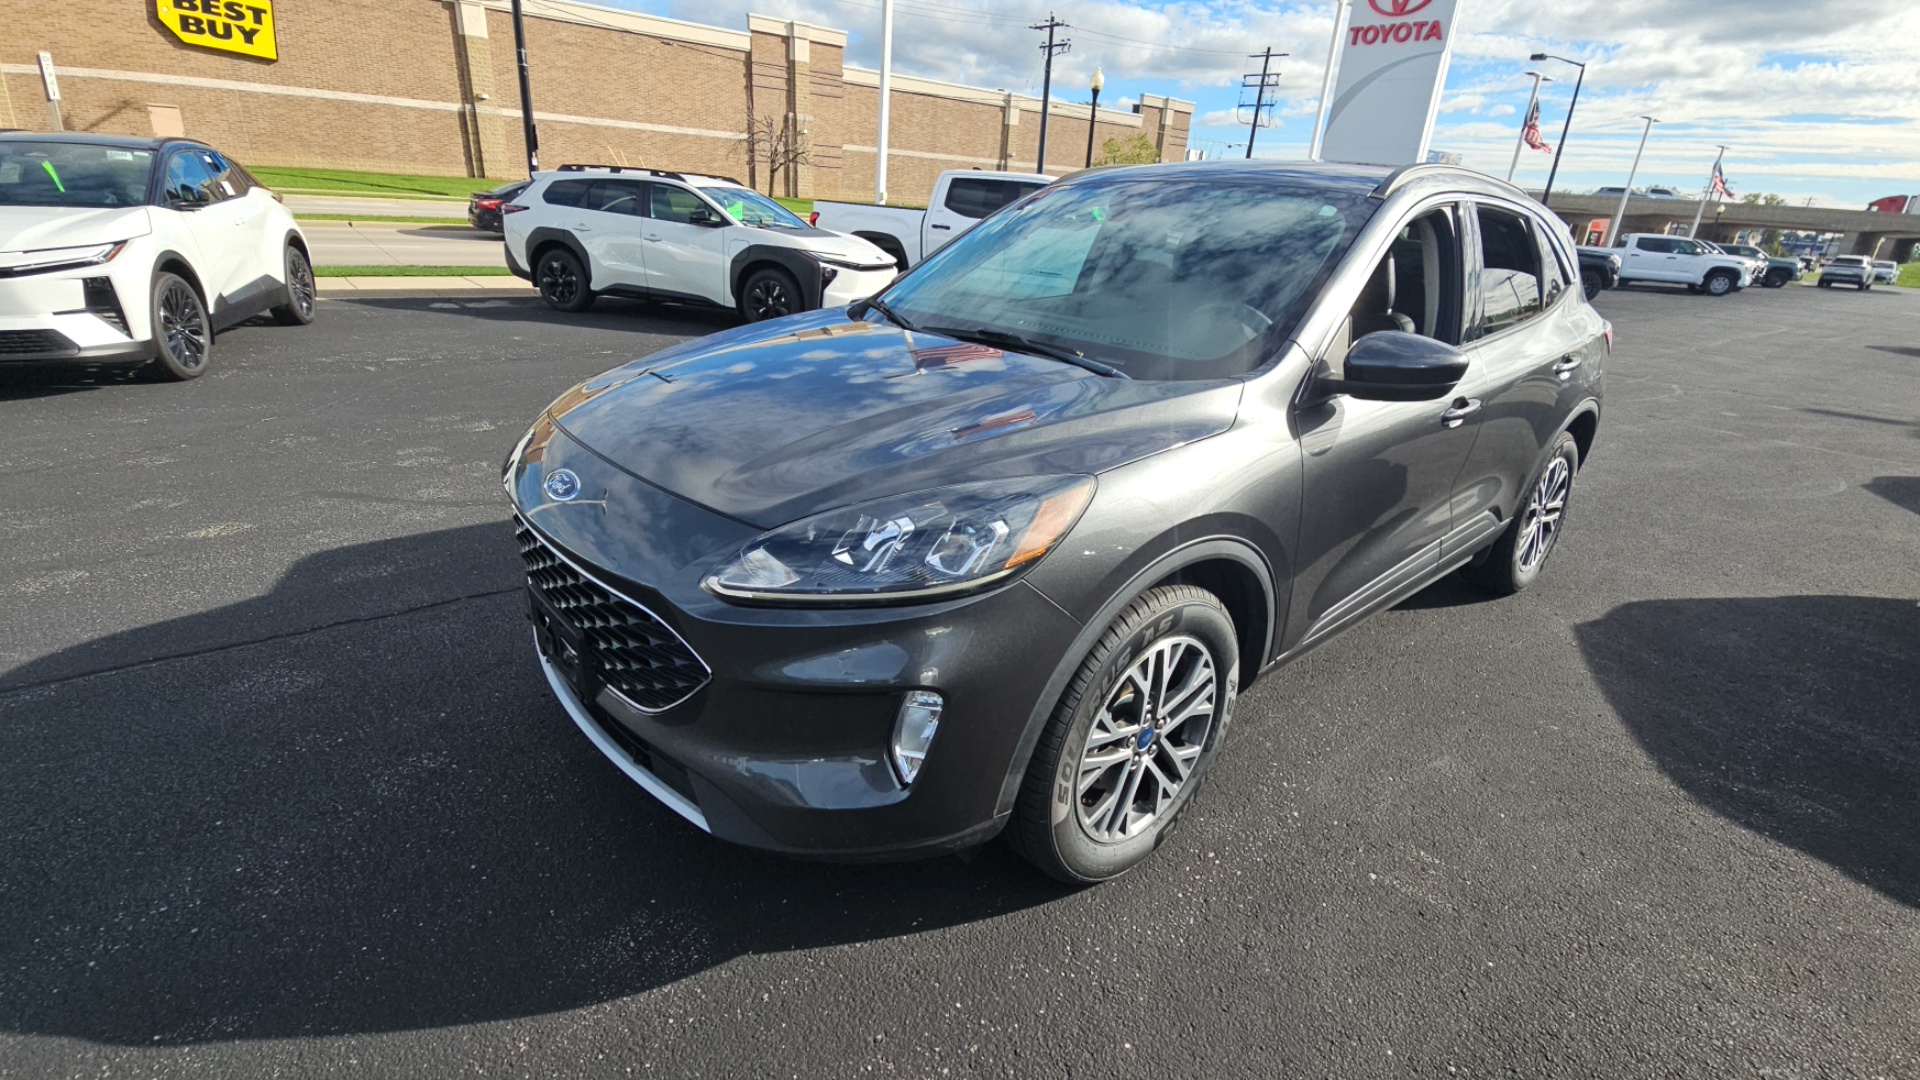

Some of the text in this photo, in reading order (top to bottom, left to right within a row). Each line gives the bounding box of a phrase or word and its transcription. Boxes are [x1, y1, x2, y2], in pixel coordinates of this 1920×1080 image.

[178, 13, 261, 46] BUY
[1350, 20, 1442, 46] TOYOTA
[546, 472, 573, 495] Ford
